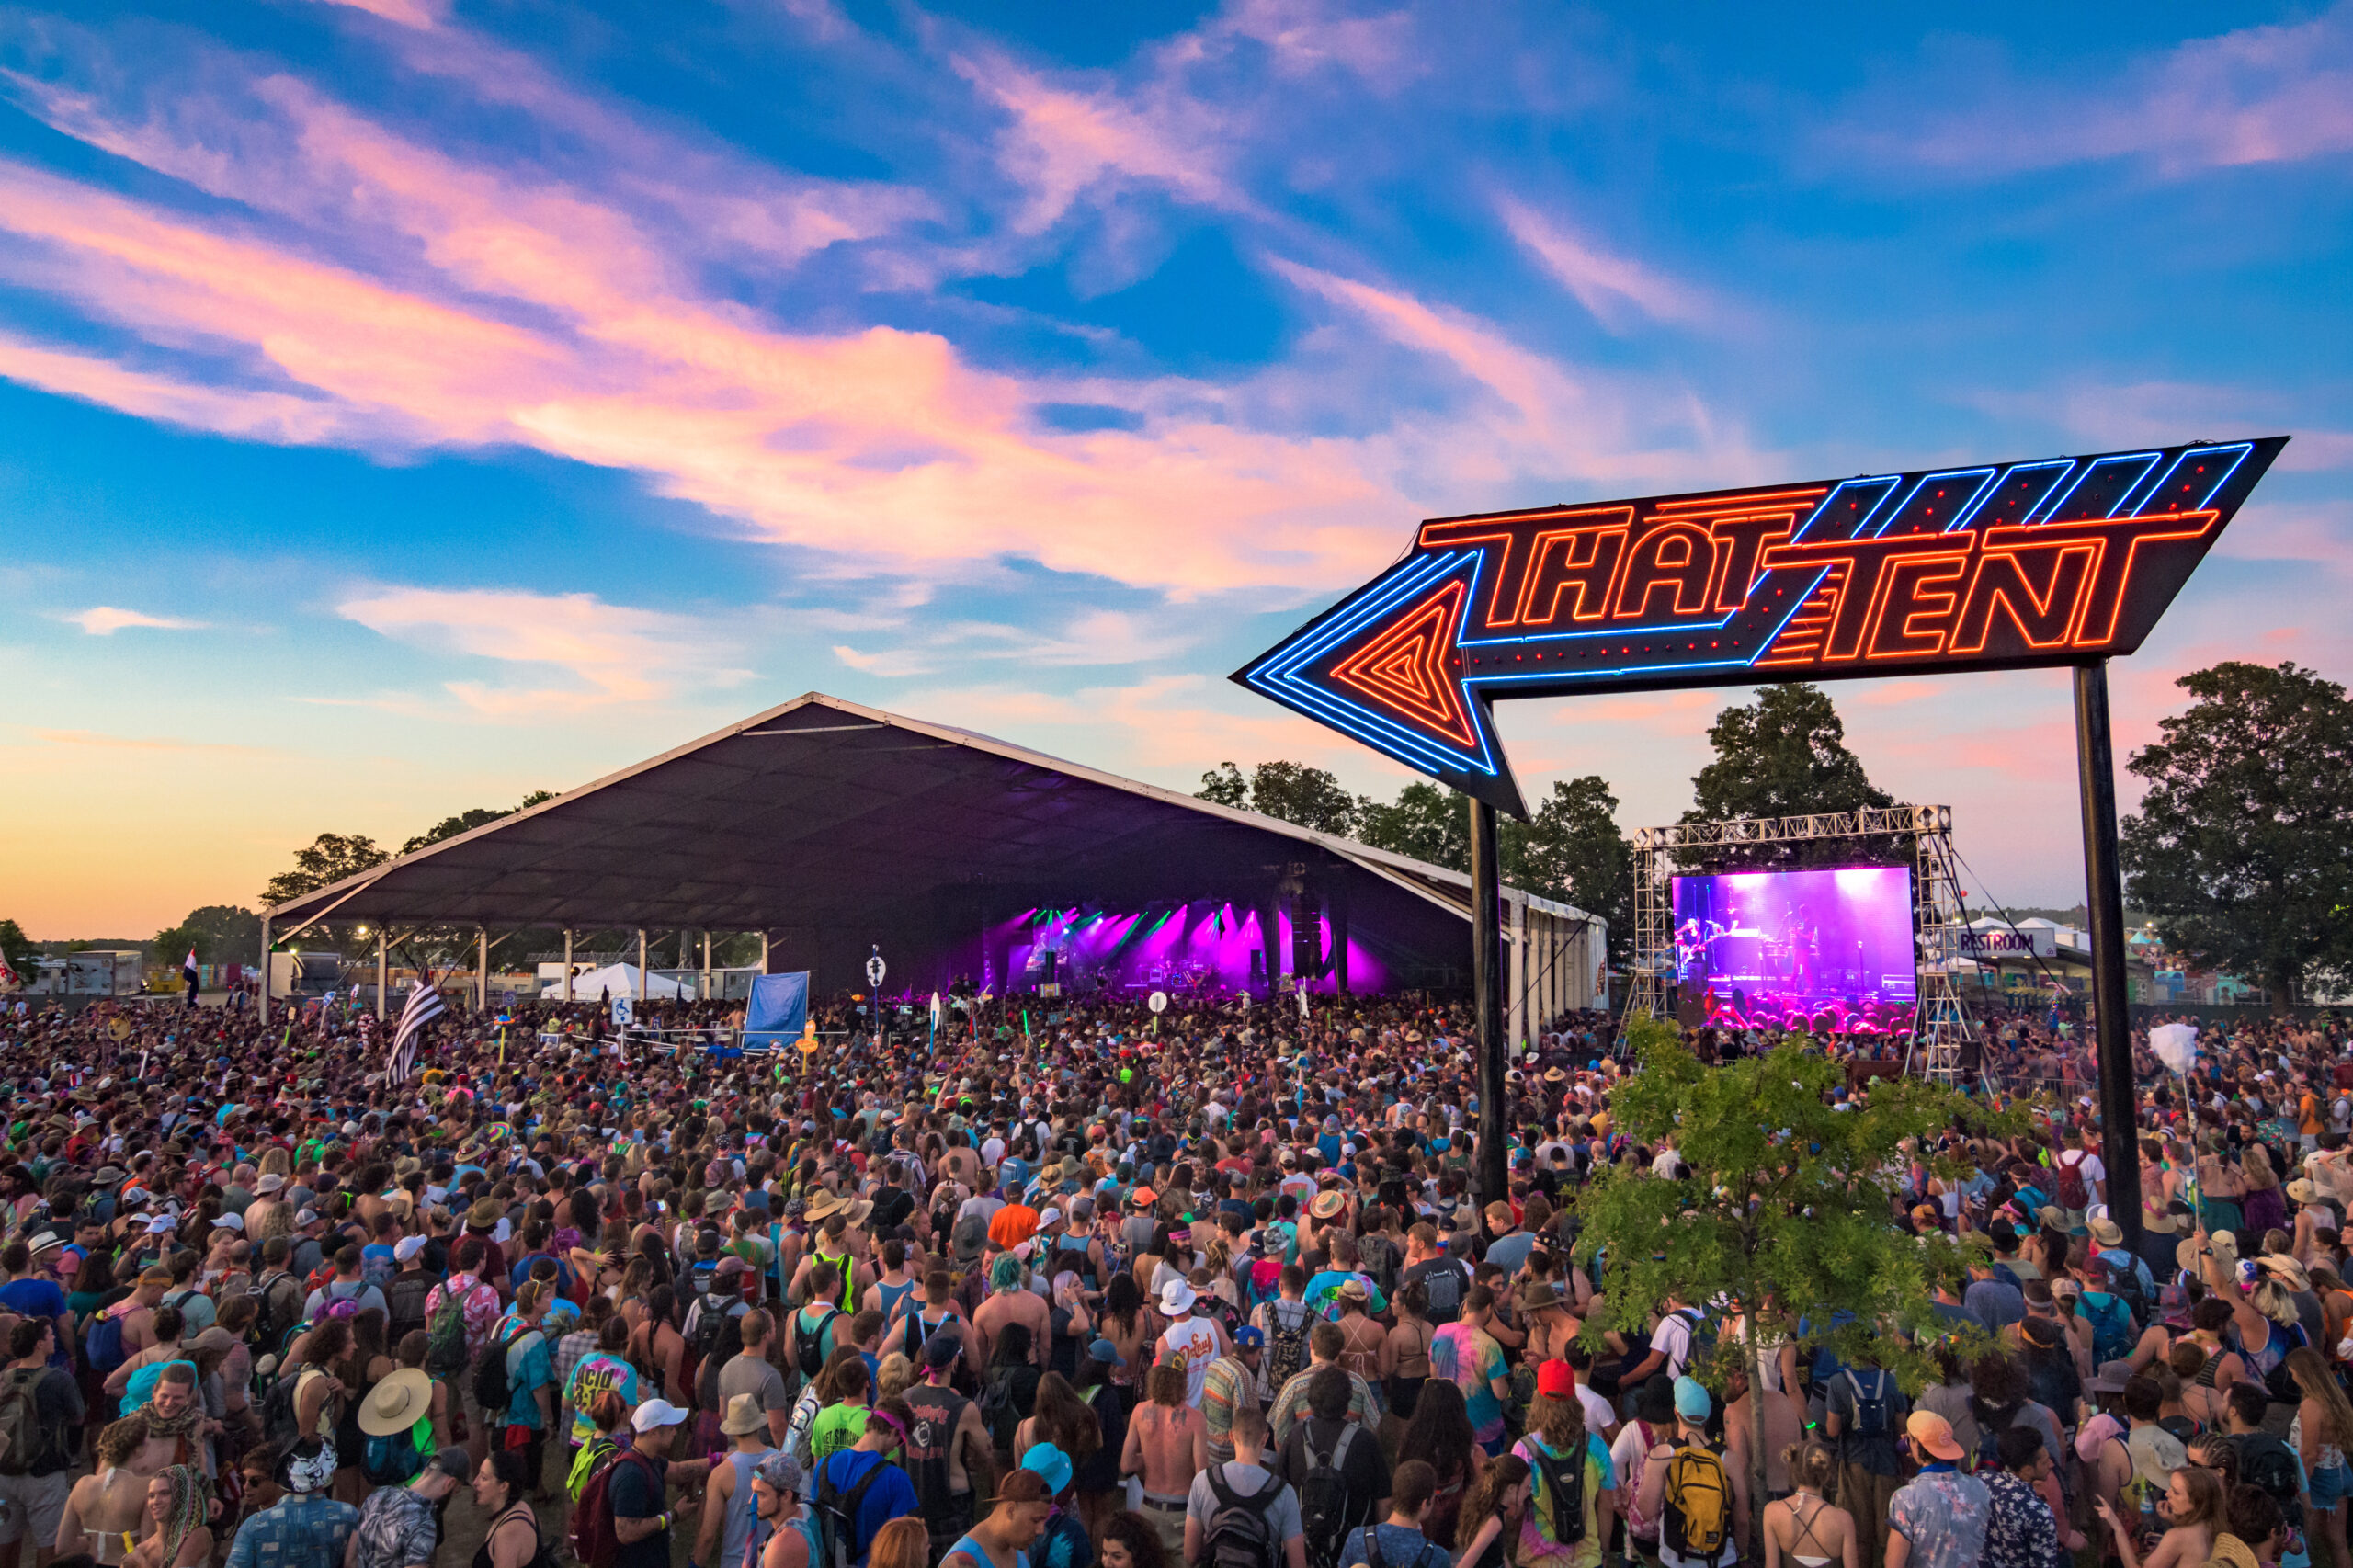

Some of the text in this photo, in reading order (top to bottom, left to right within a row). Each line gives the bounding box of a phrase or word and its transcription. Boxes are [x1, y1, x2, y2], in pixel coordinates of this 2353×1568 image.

[1420, 504, 1795, 627] THAT
[1762, 509, 2220, 661] TENT
[1961, 934, 2034, 951] RESTROOM
[575, 1363, 615, 1389] Acid
